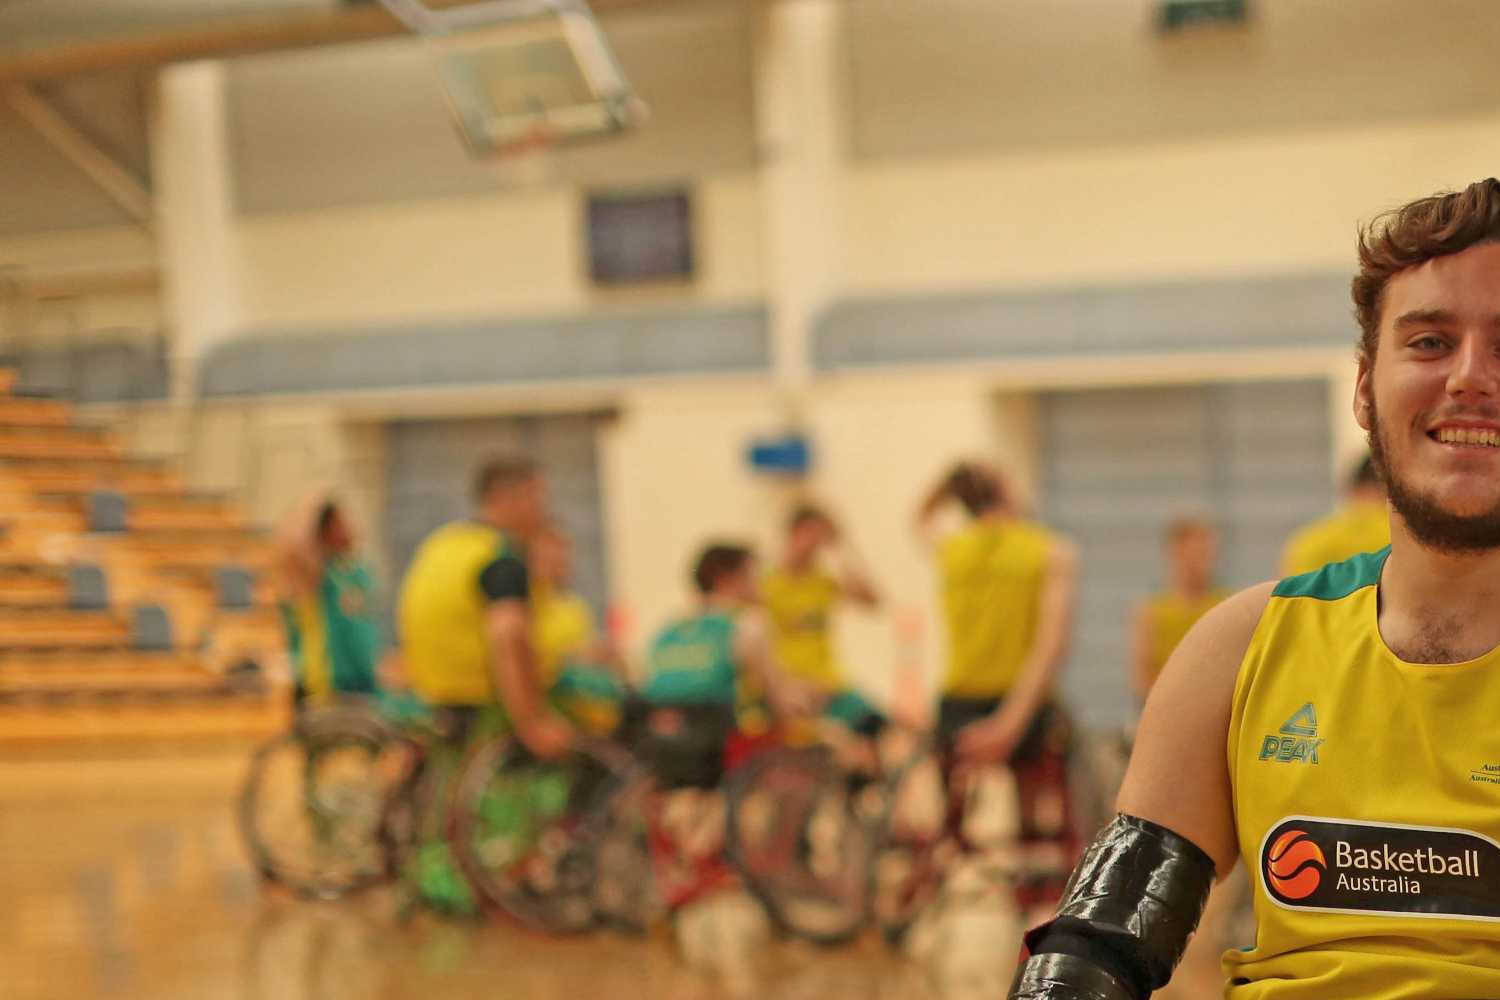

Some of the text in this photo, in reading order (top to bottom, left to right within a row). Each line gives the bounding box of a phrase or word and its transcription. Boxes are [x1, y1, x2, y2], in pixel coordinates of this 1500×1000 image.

[1258, 734, 1325, 765] PEAK
[1336, 840, 1480, 877] Basketball
[1336, 872, 1421, 894] Australia
